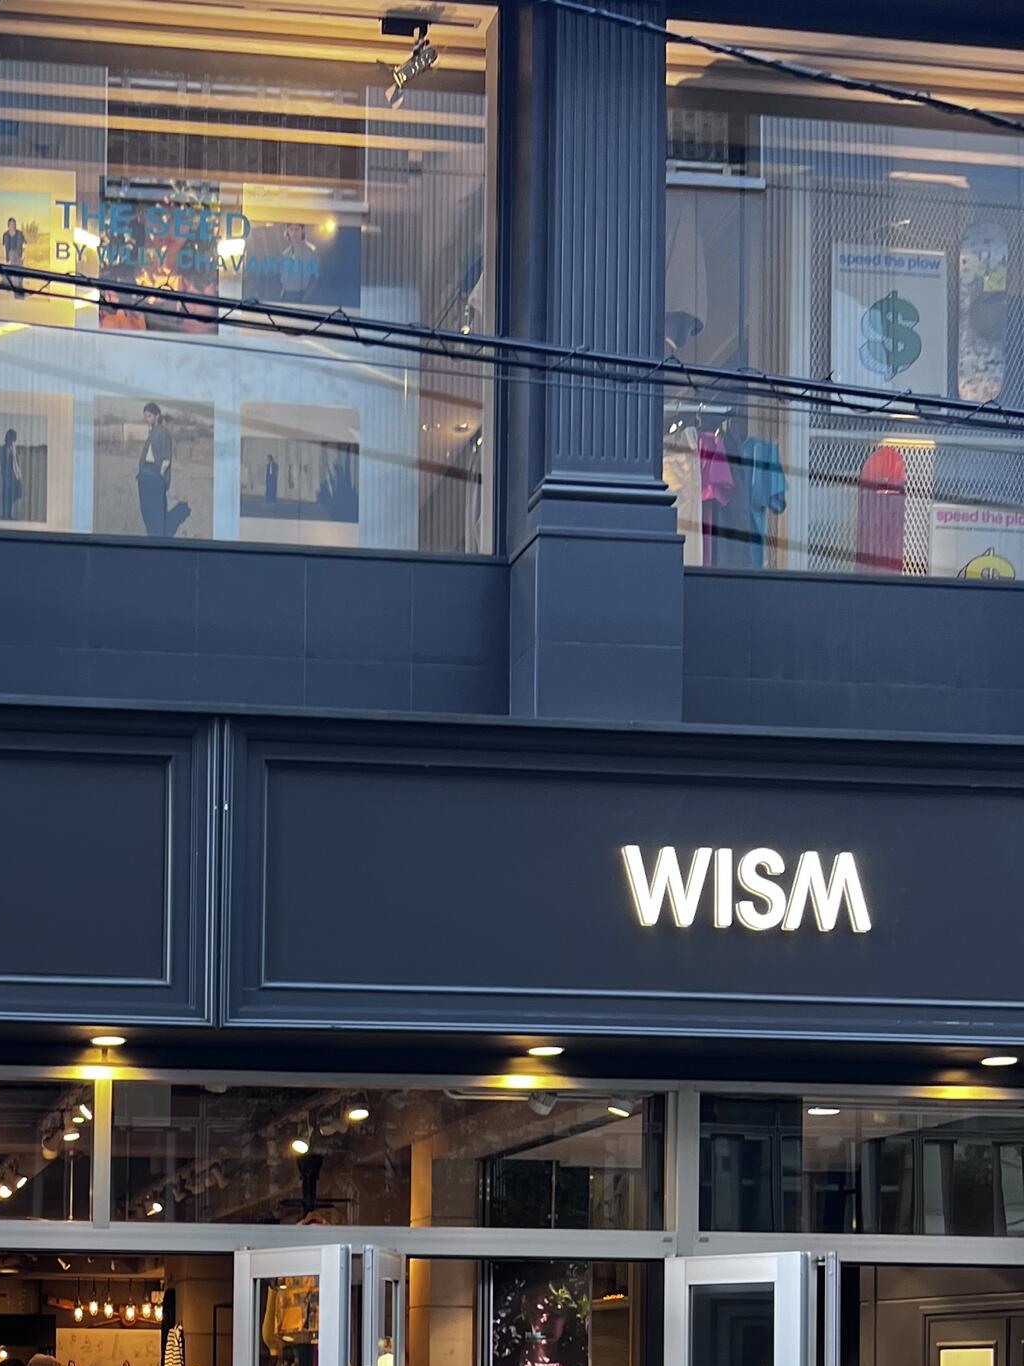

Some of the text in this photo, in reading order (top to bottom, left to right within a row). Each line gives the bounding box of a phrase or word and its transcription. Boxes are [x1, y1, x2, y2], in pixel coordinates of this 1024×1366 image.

[55, 199, 251, 241] THE SEED
[56, 241, 87, 261] BY
[936, 510, 979, 523] speed
[982, 509, 1003, 525] the
[621, 844, 872, 933] WISM
